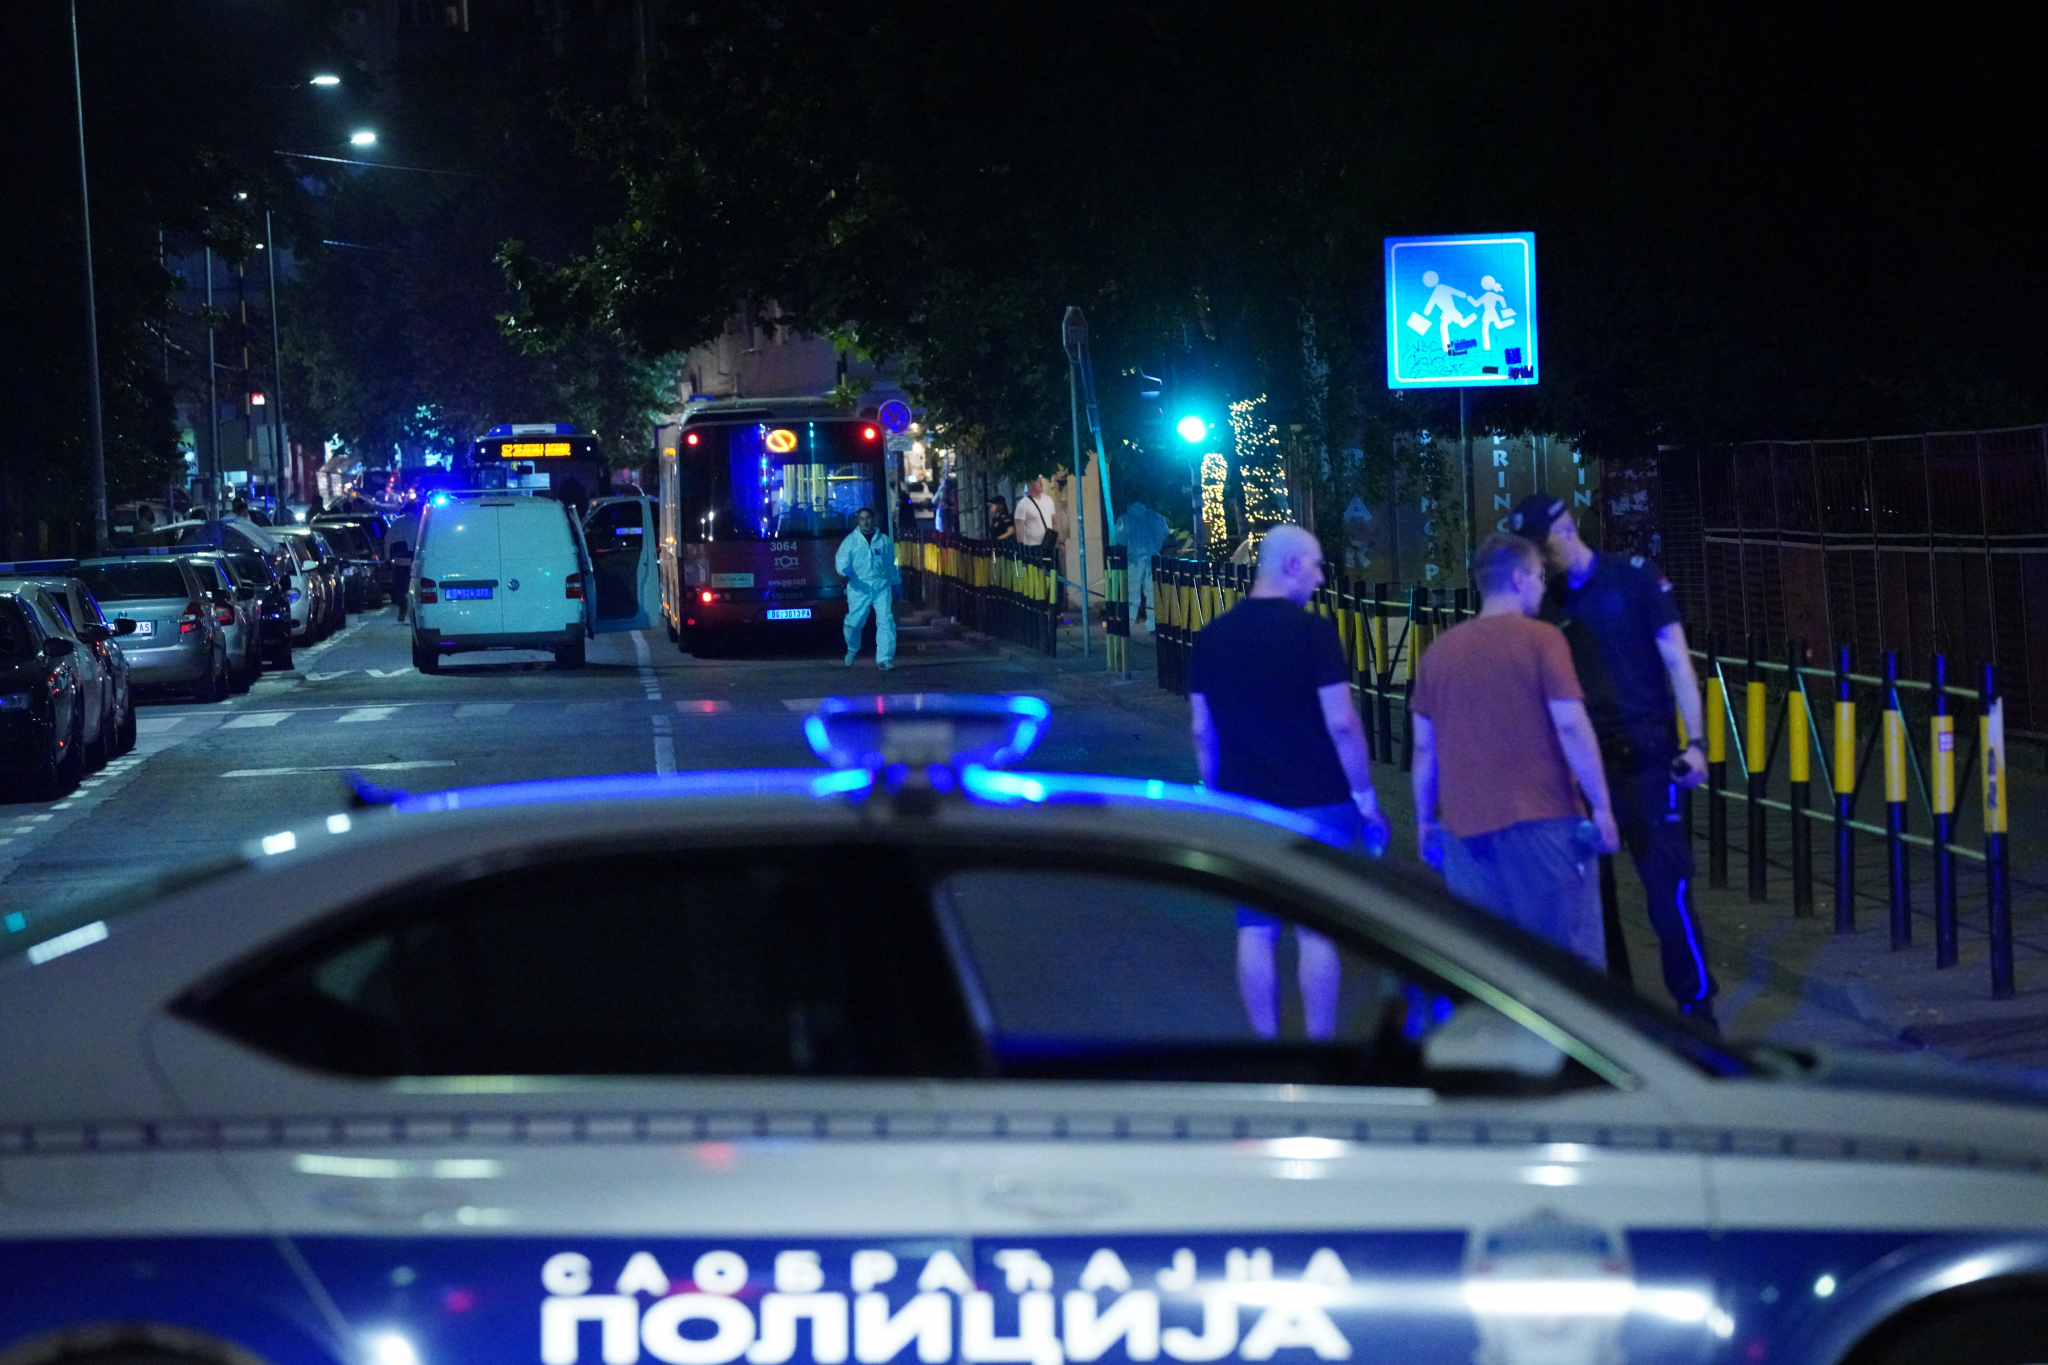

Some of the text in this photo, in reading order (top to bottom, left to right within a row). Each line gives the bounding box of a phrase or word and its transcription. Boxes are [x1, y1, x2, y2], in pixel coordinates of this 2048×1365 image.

[770, 541, 797, 551] 3064
[541, 1247, 1353, 1296] САОБРАЋАЈНА
[541, 1290, 1354, 1365] ПОЛИЦИЈА
